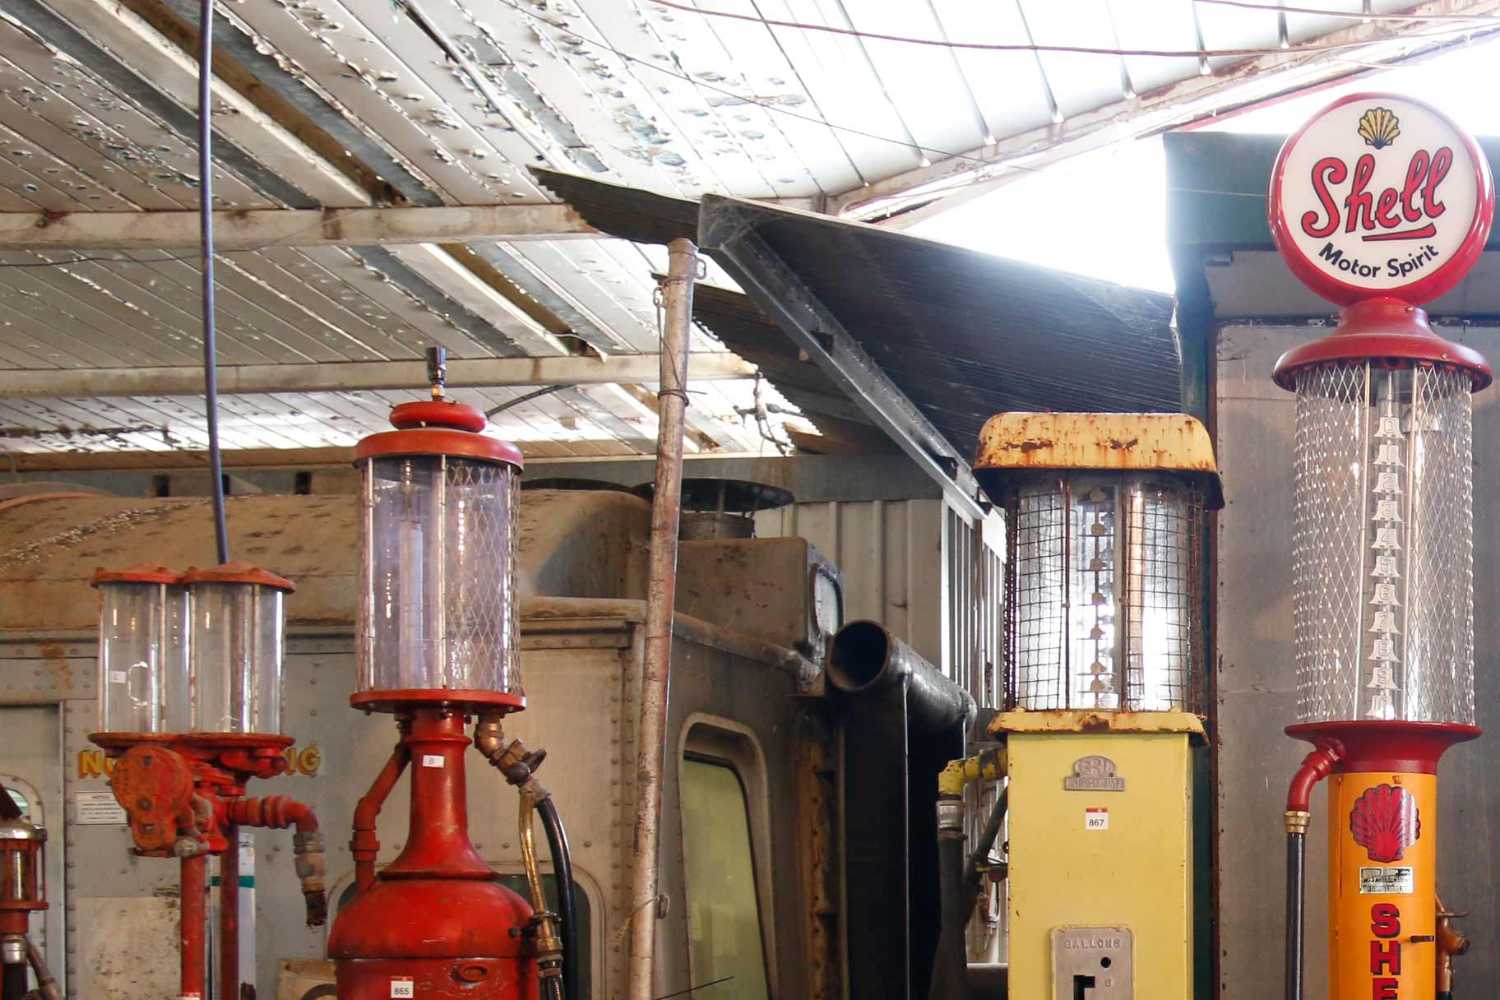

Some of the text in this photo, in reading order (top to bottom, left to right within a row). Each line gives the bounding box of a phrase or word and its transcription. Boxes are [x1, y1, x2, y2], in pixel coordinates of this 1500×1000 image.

[1301, 146, 1453, 239] Shell
[1318, 242, 1439, 278] Motor Spirit
[1088, 818, 1105, 828] 867
